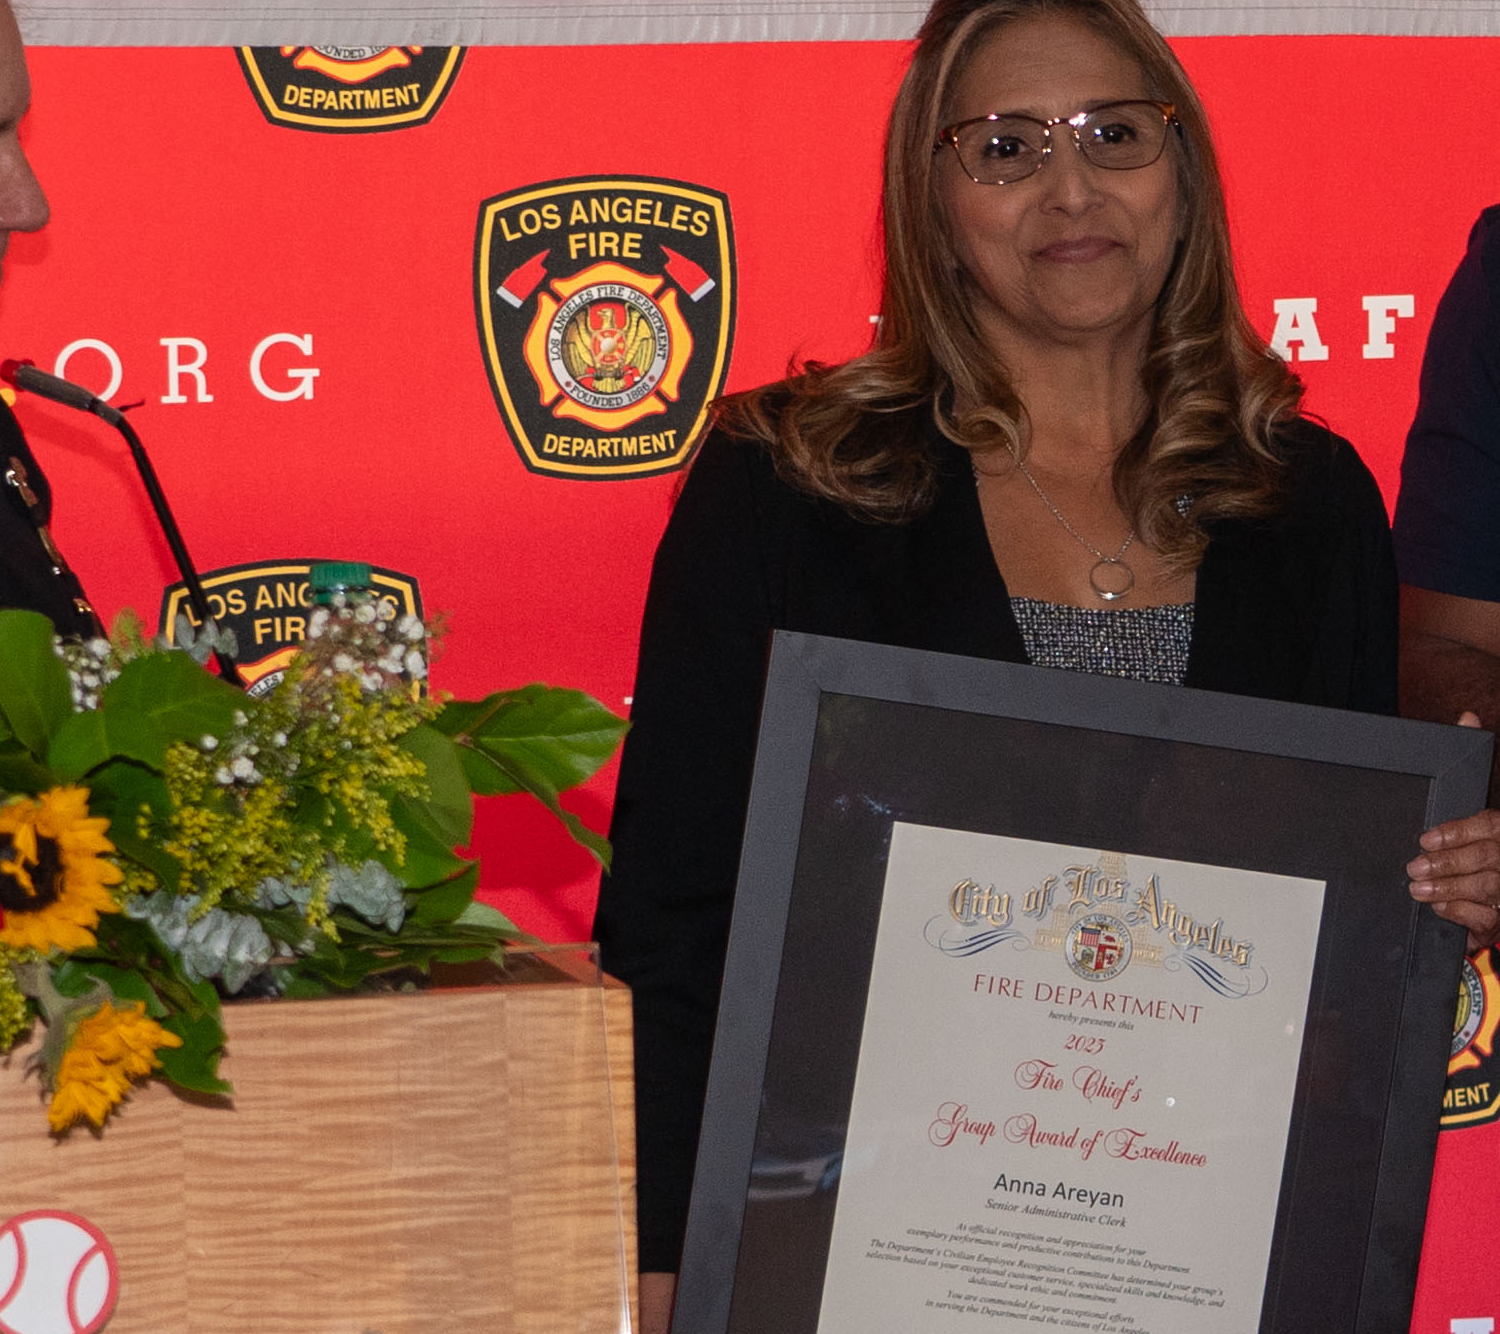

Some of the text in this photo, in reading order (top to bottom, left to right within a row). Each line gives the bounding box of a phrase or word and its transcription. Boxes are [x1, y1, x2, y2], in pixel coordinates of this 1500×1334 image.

[283, 83, 420, 110] DEPARTMENT
[500, 197, 711, 242] LOS ANGELES
[568, 232, 643, 260] FIRE
[554, 290, 595, 336] ANGELES
[597, 285, 625, 298] FIRE
[628, 290, 668, 361] DEPARTMENT
[569, 382, 651, 407] FOUNDED 1886
[543, 430, 677, 458] DEPARTMENT
[254, 616, 306, 644] FIR
[949, 875, 1013, 926] City
[1022, 876, 1058, 918] of
[1063, 864, 1127, 910] Los
[1126, 873, 1253, 968] Angeles
[974, 973, 1204, 1024] FIRE DEPARTMENT
[1048, 1010, 1135, 1031] hereby presents this
[1064, 1034, 1105, 1055] 2023
[1014, 1059, 1142, 1110] Fire Chief's
[928, 1101, 1208, 1168] Group Award of Excellence
[993, 1172, 1125, 1209] Anna Areyan
[985, 1198, 1127, 1228] Senior Administrative Clerk
